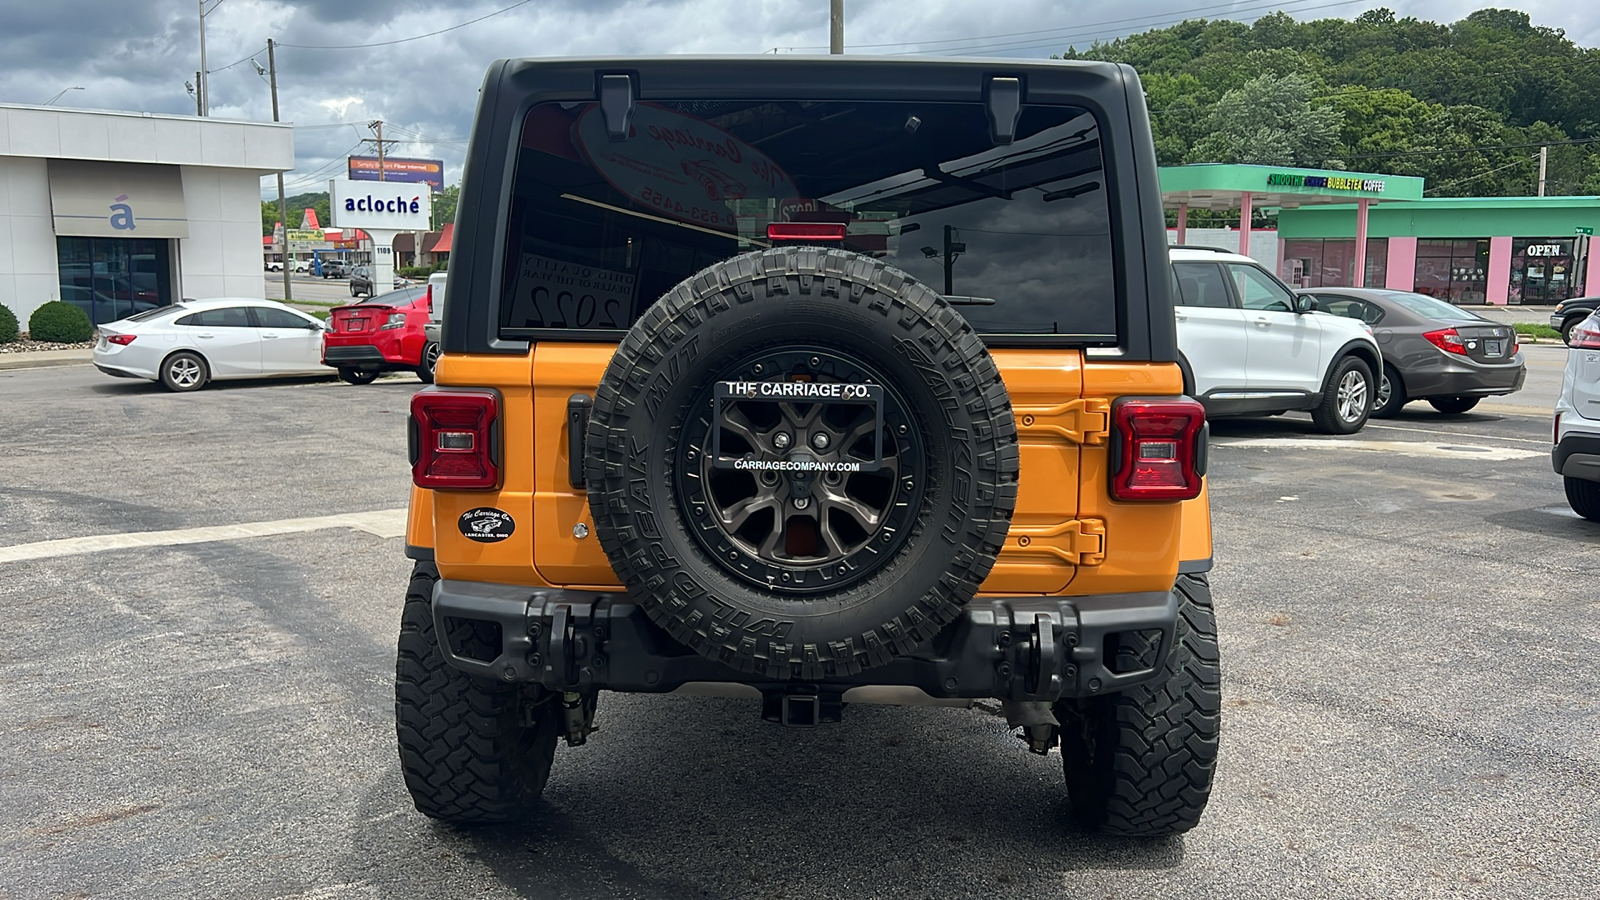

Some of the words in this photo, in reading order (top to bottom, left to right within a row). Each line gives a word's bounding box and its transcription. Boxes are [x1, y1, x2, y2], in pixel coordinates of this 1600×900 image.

[1363, 179, 1385, 192] COFFEE
[345, 194, 420, 213] acloché
[109, 194, 137, 231] á
[376, 247, 391, 255] 1109
[1527, 244, 1561, 257] OPEN
[726, 382, 757, 395] THE
[760, 383, 840, 397] CARRIAGE
[844, 384, 871, 398] CO.
[893, 333, 974, 544] FALKEN
[734, 460, 860, 472] CARRIAGECOMPANY.COM
[462, 511, 473, 521] The
[473, 509, 500, 519] Carriage
